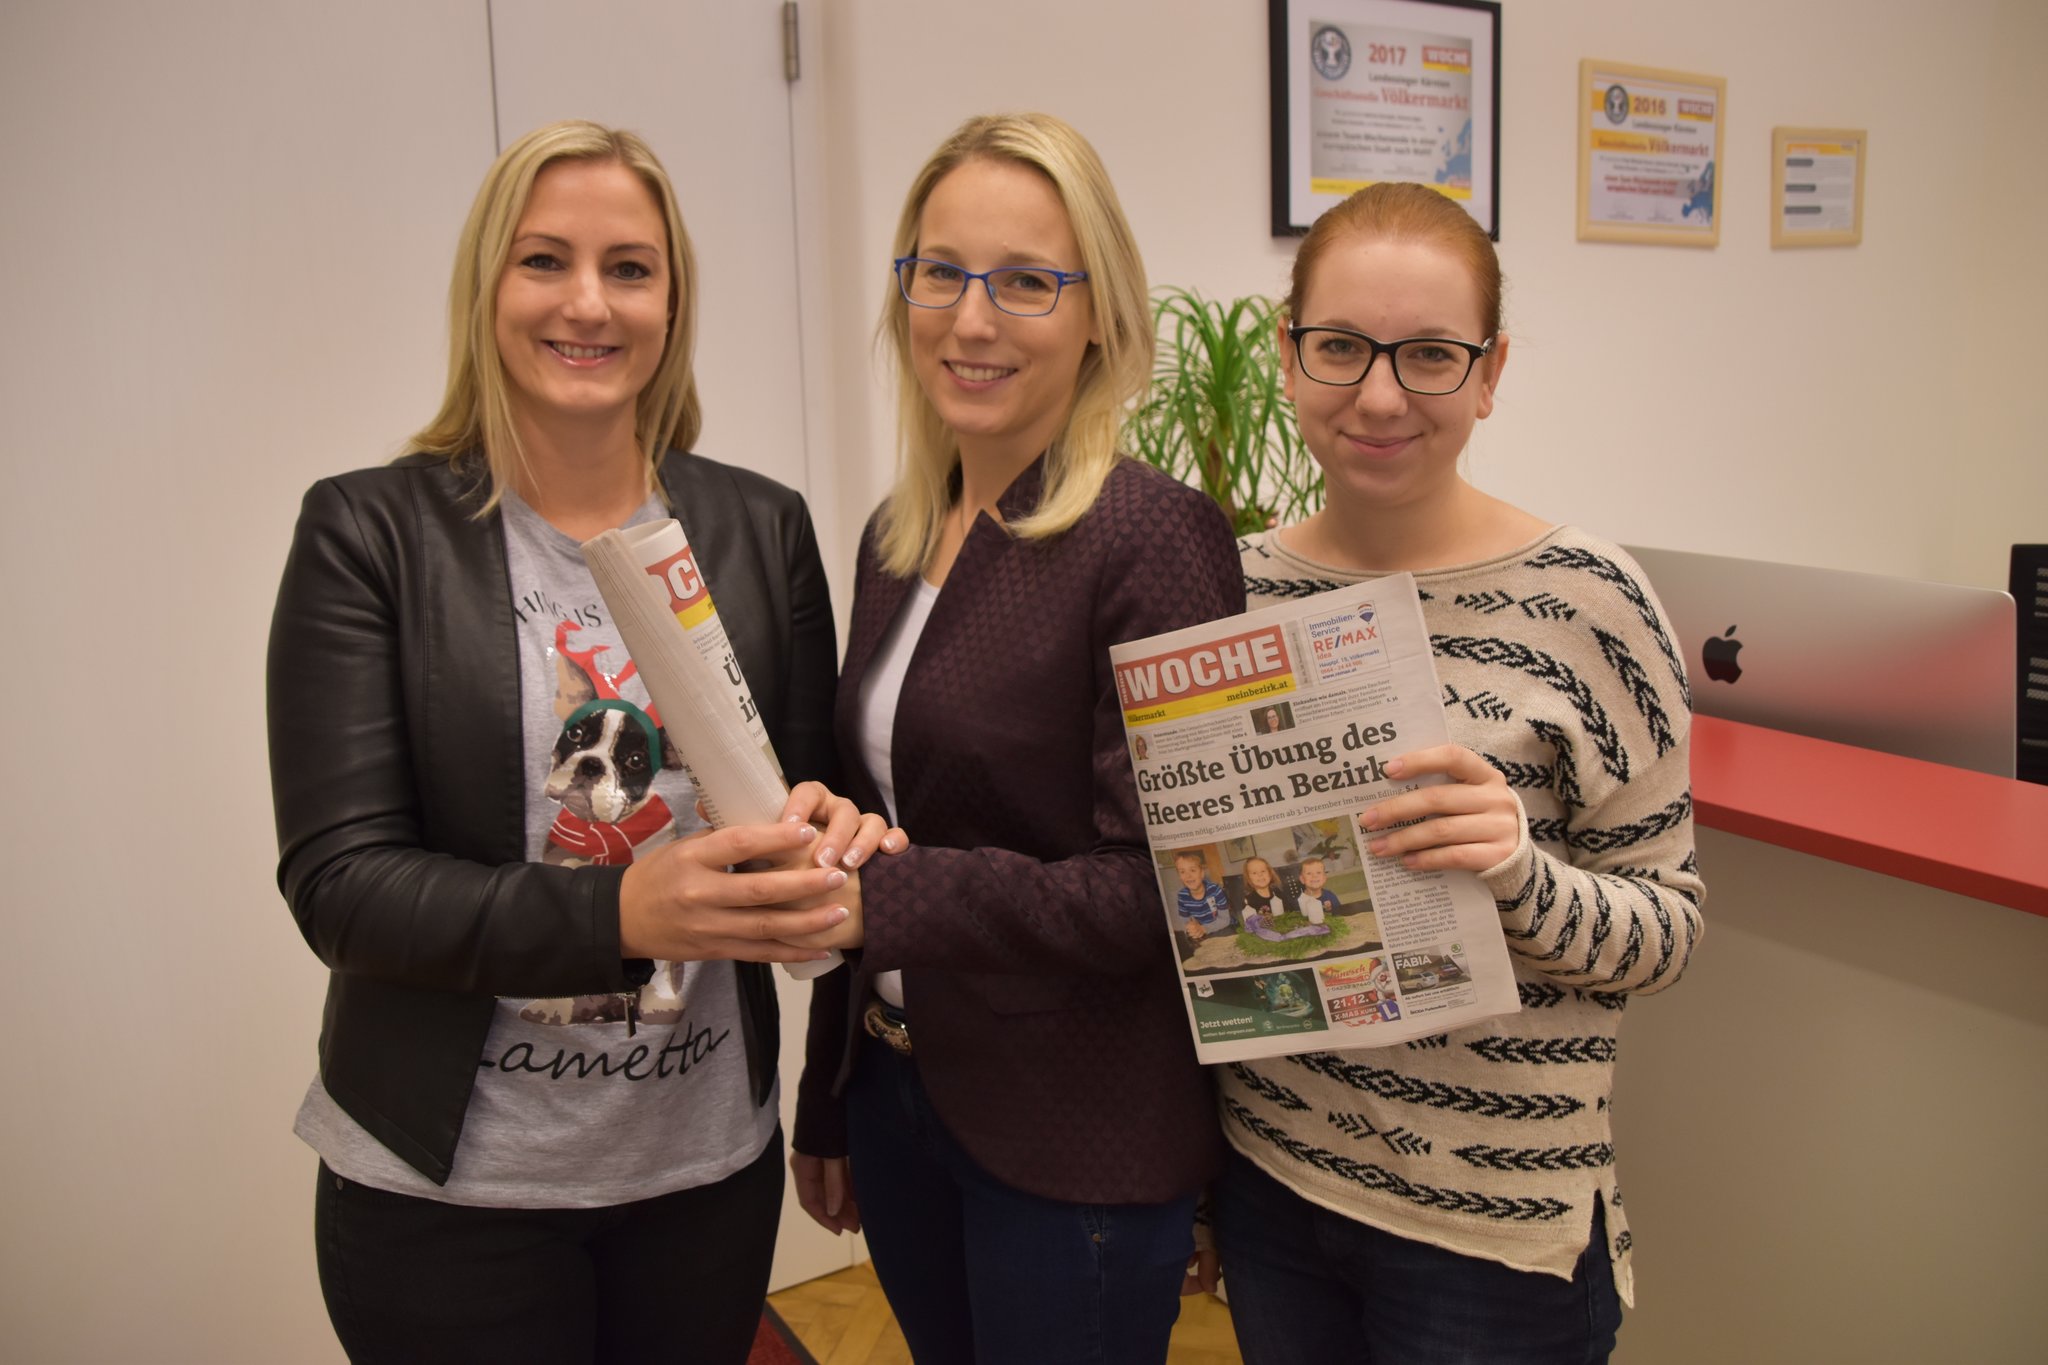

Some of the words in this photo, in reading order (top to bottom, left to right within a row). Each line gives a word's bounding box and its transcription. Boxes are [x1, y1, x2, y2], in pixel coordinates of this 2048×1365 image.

[1368, 43, 1406, 67] 2017
[1381, 87, 1469, 111] Völkermarkt
[1634, 95, 1666, 115] 2016
[574, 603, 602, 628] IS
[1309, 614, 1355, 630] Immobilien-
[1311, 626, 1340, 638] Service
[1313, 625, 1378, 653] RE/MAX
[1124, 633, 1283, 702] WOCHE
[1227, 680, 1289, 702] meinbezirk.at
[1138, 757, 1226, 793] Größte
[1229, 744, 1337, 775] Übung
[1342, 721, 1397, 752] des
[1144, 795, 1234, 826] Heeres
[1240, 783, 1286, 809] im
[1288, 755, 1390, 798] Bezirk
[1215, 821, 1248, 833] Soldaten
[1248, 813, 1285, 826] trainieren
[1286, 809, 1296, 818] ab
[1304, 800, 1342, 815] Dezember
[1342, 796, 1354, 806] im
[1354, 792, 1377, 805] Raum
[1395, 956, 1432, 969] FABIA
[1332, 994, 1369, 1009] 21.12.
[1382, 1003, 1398, 1020] L
[1200, 1020, 1221, 1030] Jetzt
[1221, 1016, 1252, 1026] wetten!
